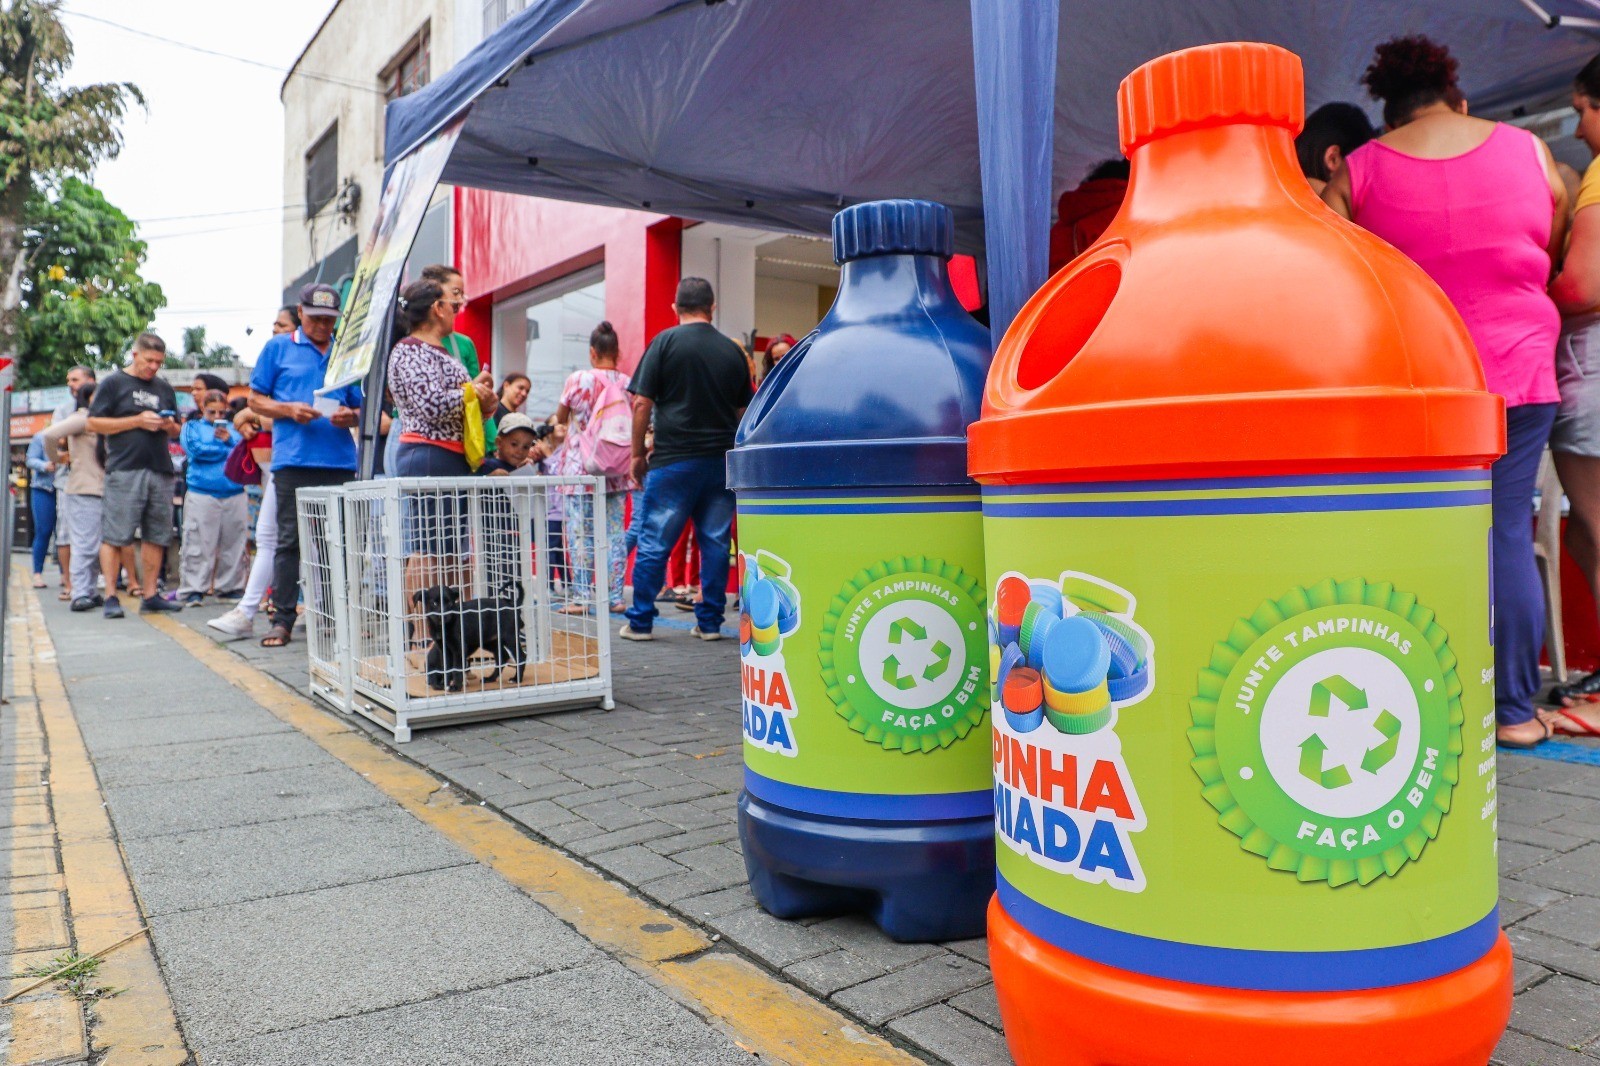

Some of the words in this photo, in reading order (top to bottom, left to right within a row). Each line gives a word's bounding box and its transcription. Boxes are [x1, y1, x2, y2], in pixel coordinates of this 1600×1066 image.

[844, 595, 873, 642] JUNTE
[873, 581, 959, 607] TAMPINHAS
[881, 710, 937, 731] FAÇA
[941, 705, 954, 718] O
[955, 665, 982, 706] BEM
[1235, 645, 1284, 715] JUNTE
[1284, 617, 1412, 655] TAMPINHAS
[1296, 820, 1381, 851] FAÇA
[1387, 809, 1405, 829] O
[1406, 747, 1440, 809] BEM
